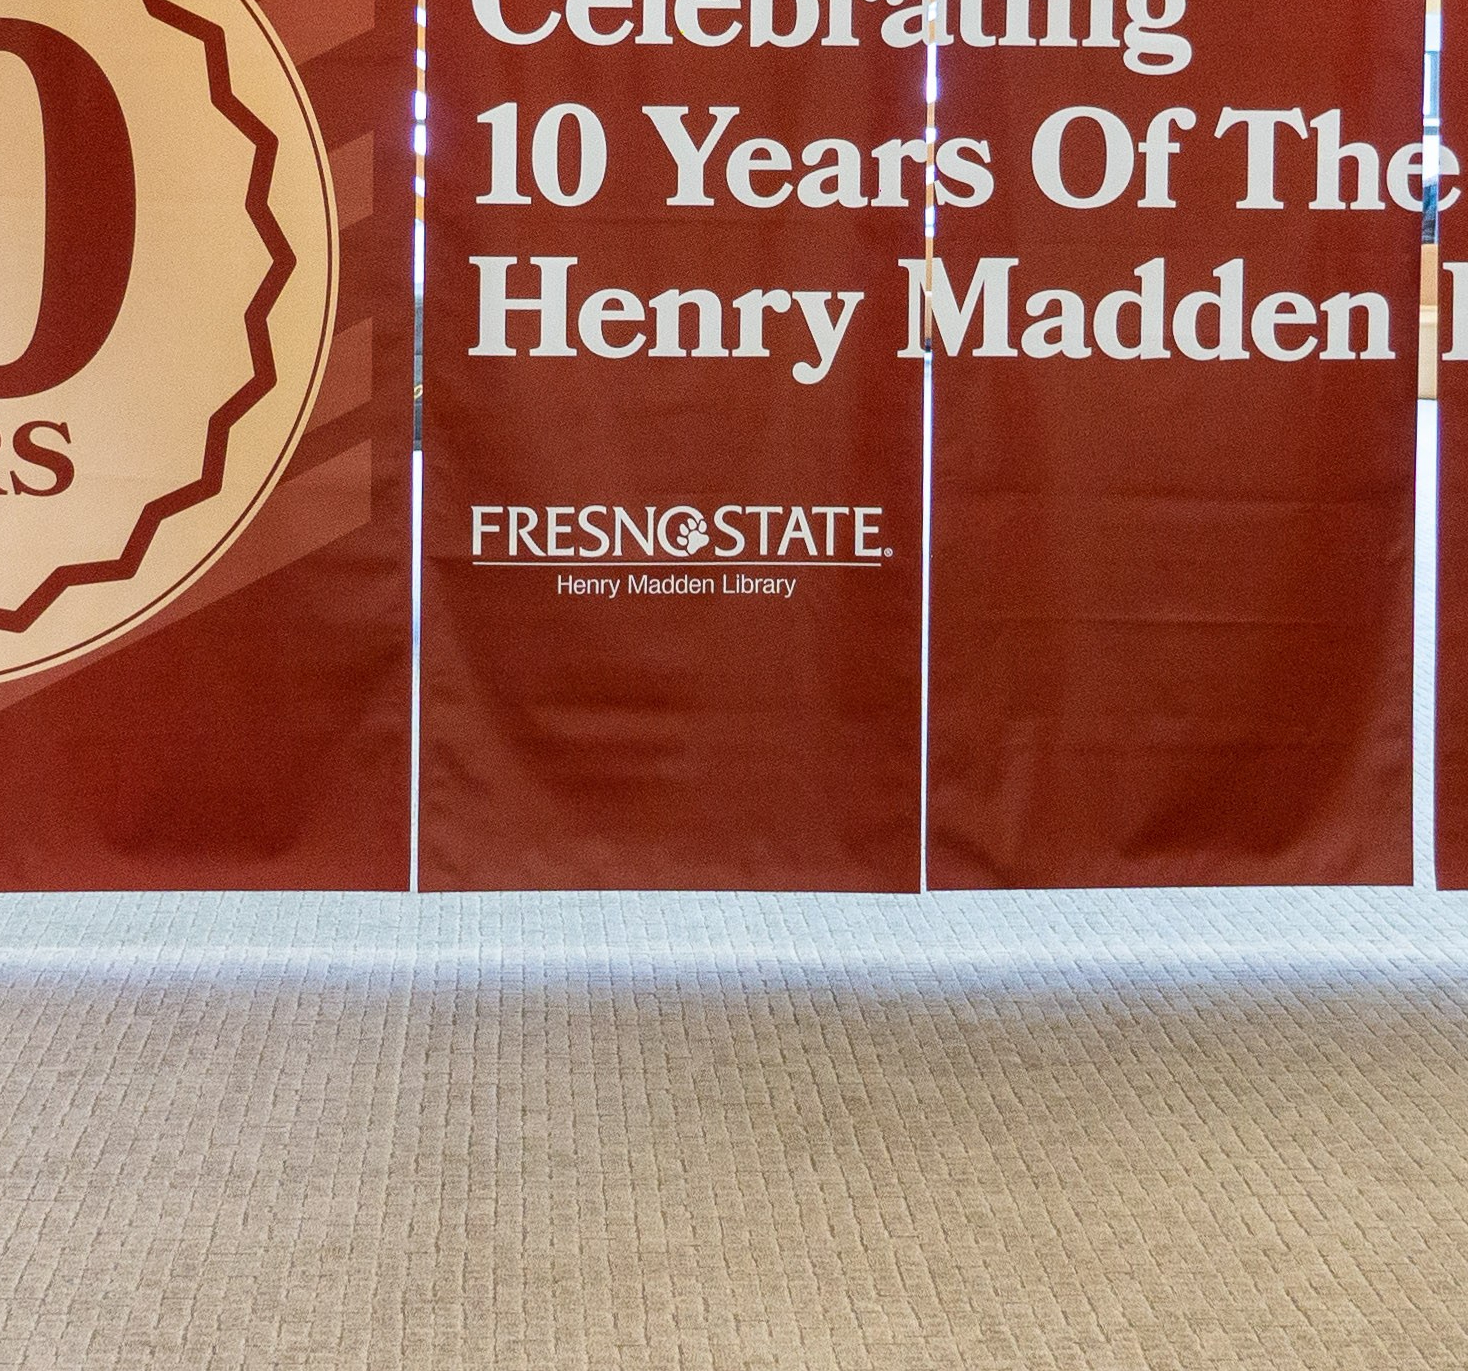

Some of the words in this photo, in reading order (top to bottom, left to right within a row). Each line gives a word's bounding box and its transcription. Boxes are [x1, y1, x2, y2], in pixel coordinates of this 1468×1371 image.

[475, 102, 607, 207] 10
[642, 105, 994, 209] Years
[1032, 106, 1196, 209] Of
[1214, 108, 1462, 212] The
[467, 256, 864, 385] Henry
[897, 258, 1395, 360] Madden
[557, 574, 621, 599] Henry
[628, 574, 715, 595] Madden
[722, 575, 797, 598] Library
